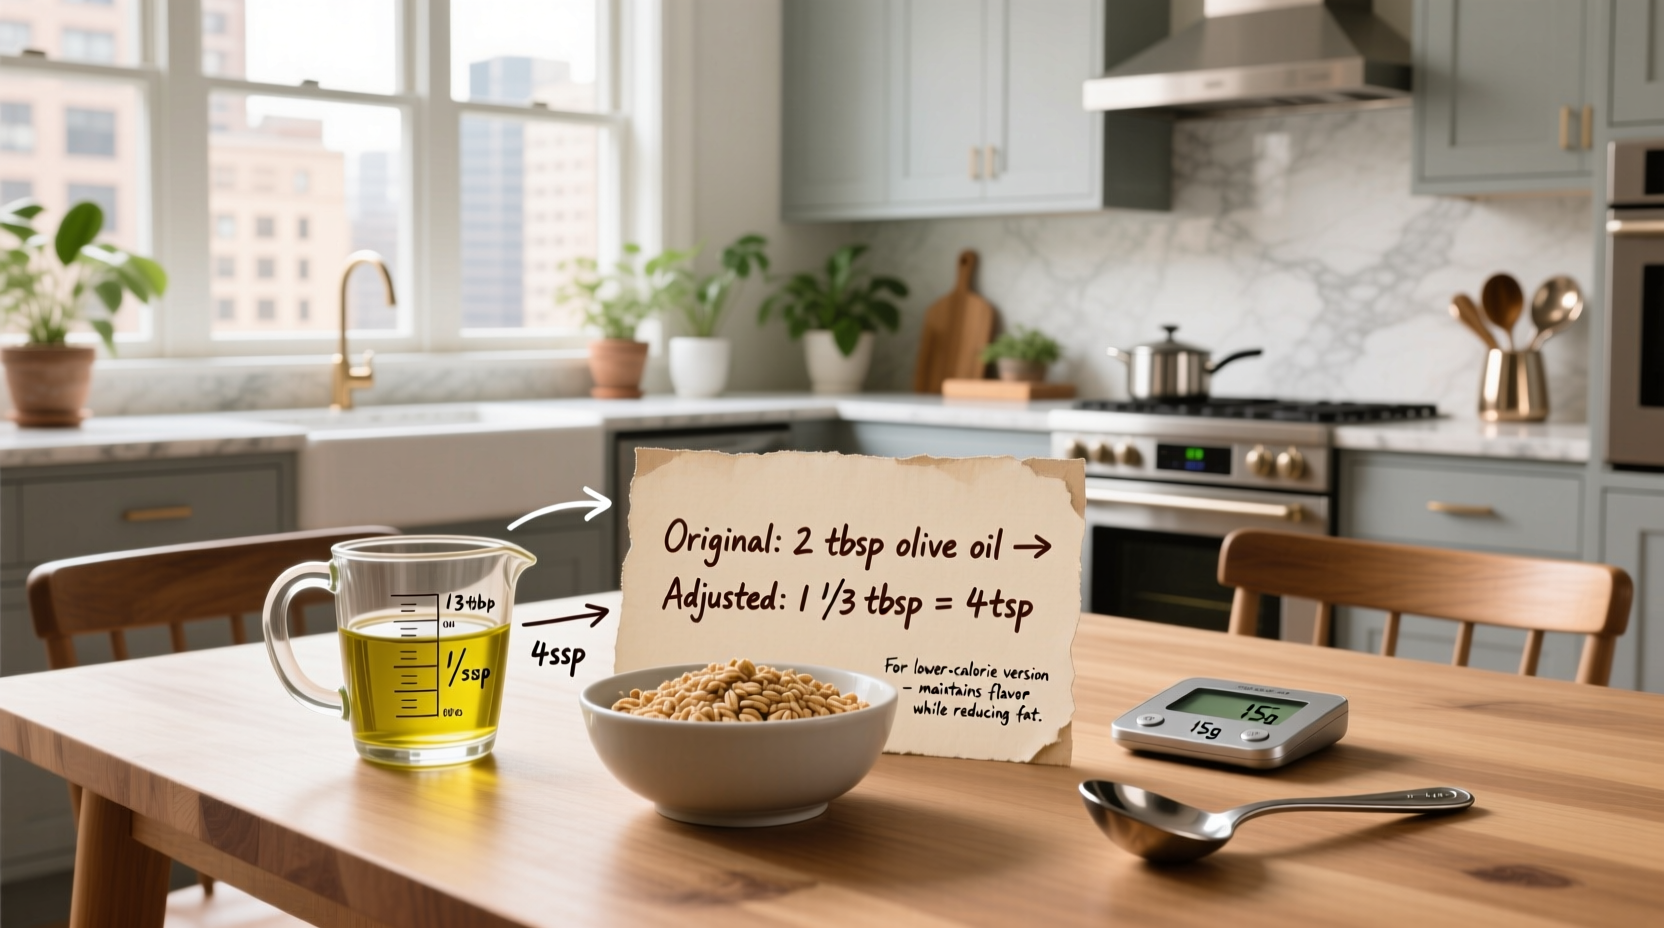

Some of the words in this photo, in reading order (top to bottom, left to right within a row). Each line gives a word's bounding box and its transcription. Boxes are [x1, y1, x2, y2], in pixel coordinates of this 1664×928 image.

[664, 517, 783, 568] Original:
[793, 526, 814, 556] 2
[824, 522, 885, 572] tbsp
[895, 525, 958, 559] olive
[969, 527, 1004, 561] oil
[661, 576, 787, 624] Adjusted:
[799, 584, 810, 613] 1
[863, 582, 923, 631] tbsp
[934, 597, 954, 611] =
[884, 656, 909, 674] For
[913, 657, 998, 679] lower-calorie
[1003, 667, 1050, 682] version
[918, 681, 982, 699] maintains
[987, 682, 1031, 701] flavor
[913, 700, 949, 717] while
[953, 702, 1010, 727] reducing
[1015, 704, 1043, 724] fat.
[1190, 719, 1222, 740] 15g
